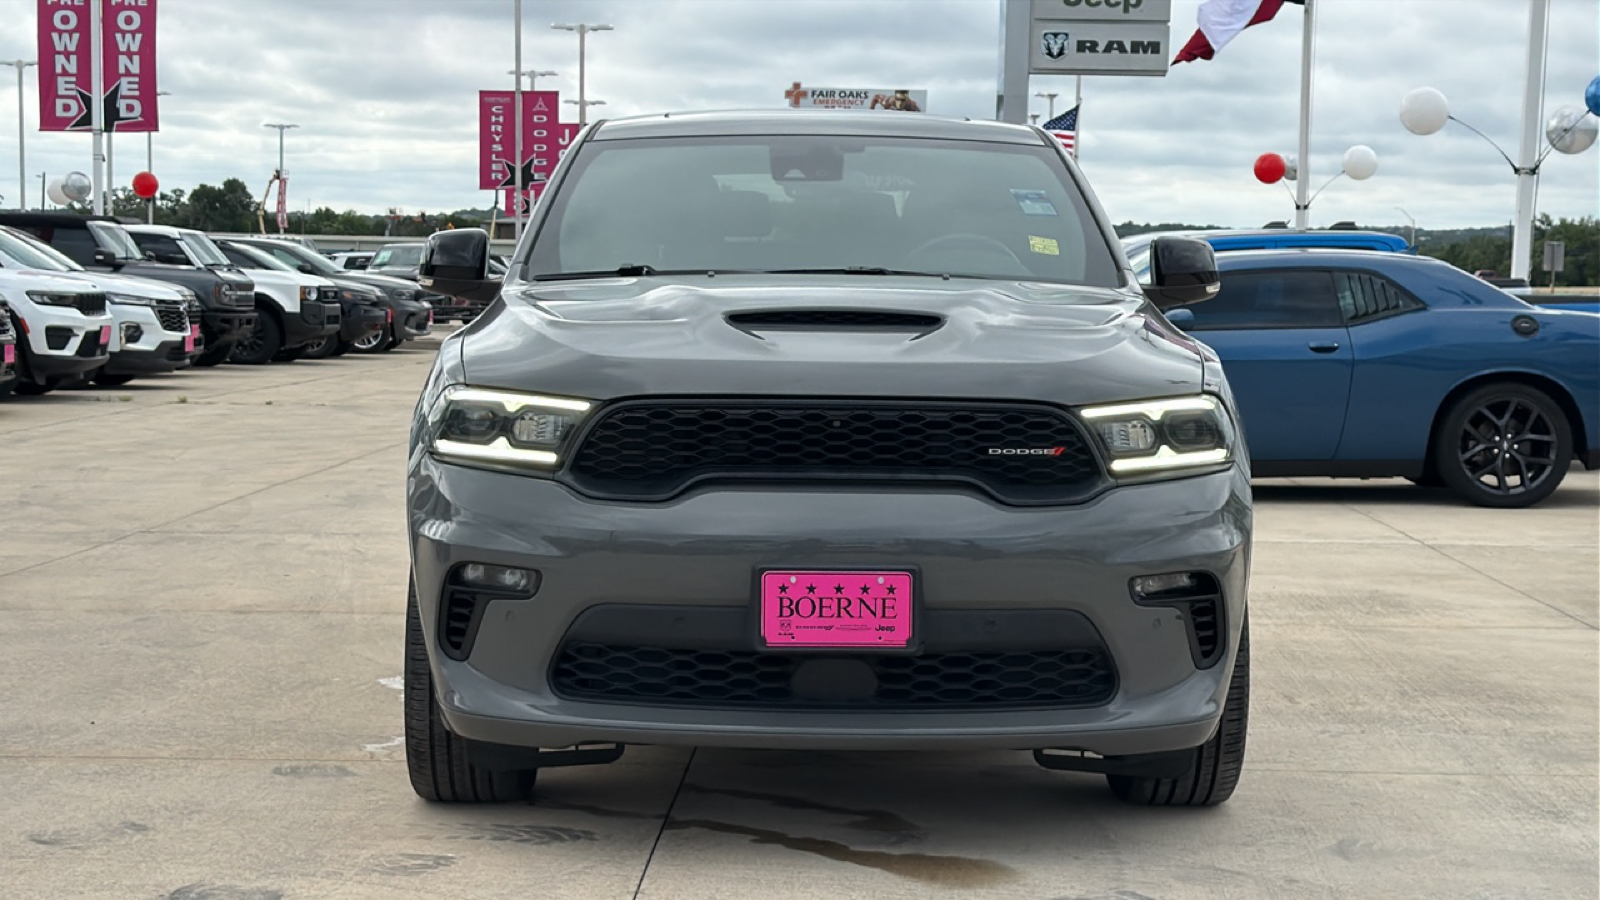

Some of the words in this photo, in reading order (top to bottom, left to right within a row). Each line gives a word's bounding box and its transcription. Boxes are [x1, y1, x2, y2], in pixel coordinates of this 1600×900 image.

[51, 10, 80, 117] OWNED
[115, 10, 142, 118] OWNED
[1076, 40, 1161, 54] RAM
[811, 90, 835, 98] FAIR
[838, 90, 869, 99] OAKS
[491, 105, 504, 180] CHRYSLER
[533, 115, 548, 180] DODGE
[777, 596, 898, 619] BOERNE
[875, 624, 895, 632] Jeep
